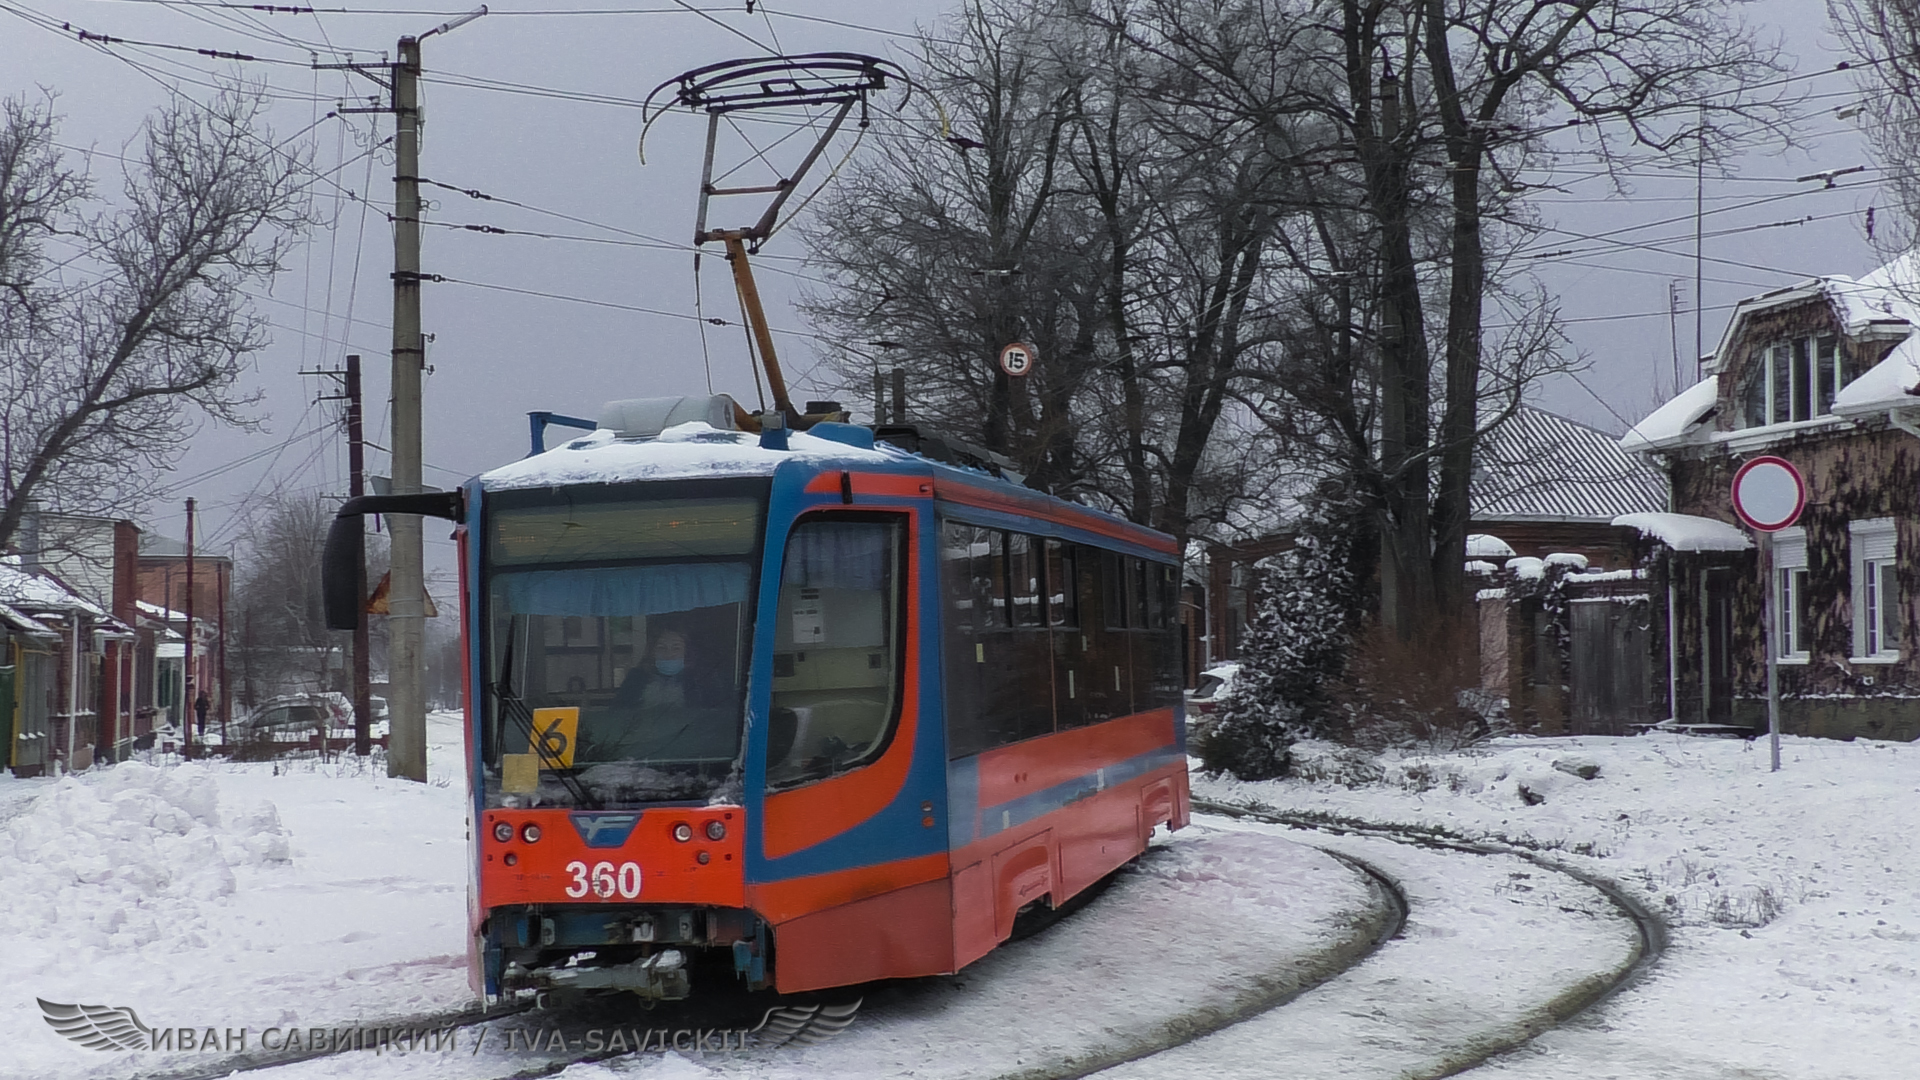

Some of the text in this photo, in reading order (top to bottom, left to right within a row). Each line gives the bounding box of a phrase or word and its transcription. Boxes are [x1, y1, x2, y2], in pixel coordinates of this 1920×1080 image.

[1008, 351, 1025, 370] 15
[538, 717, 569, 760] 6
[565, 860, 643, 899] 360
